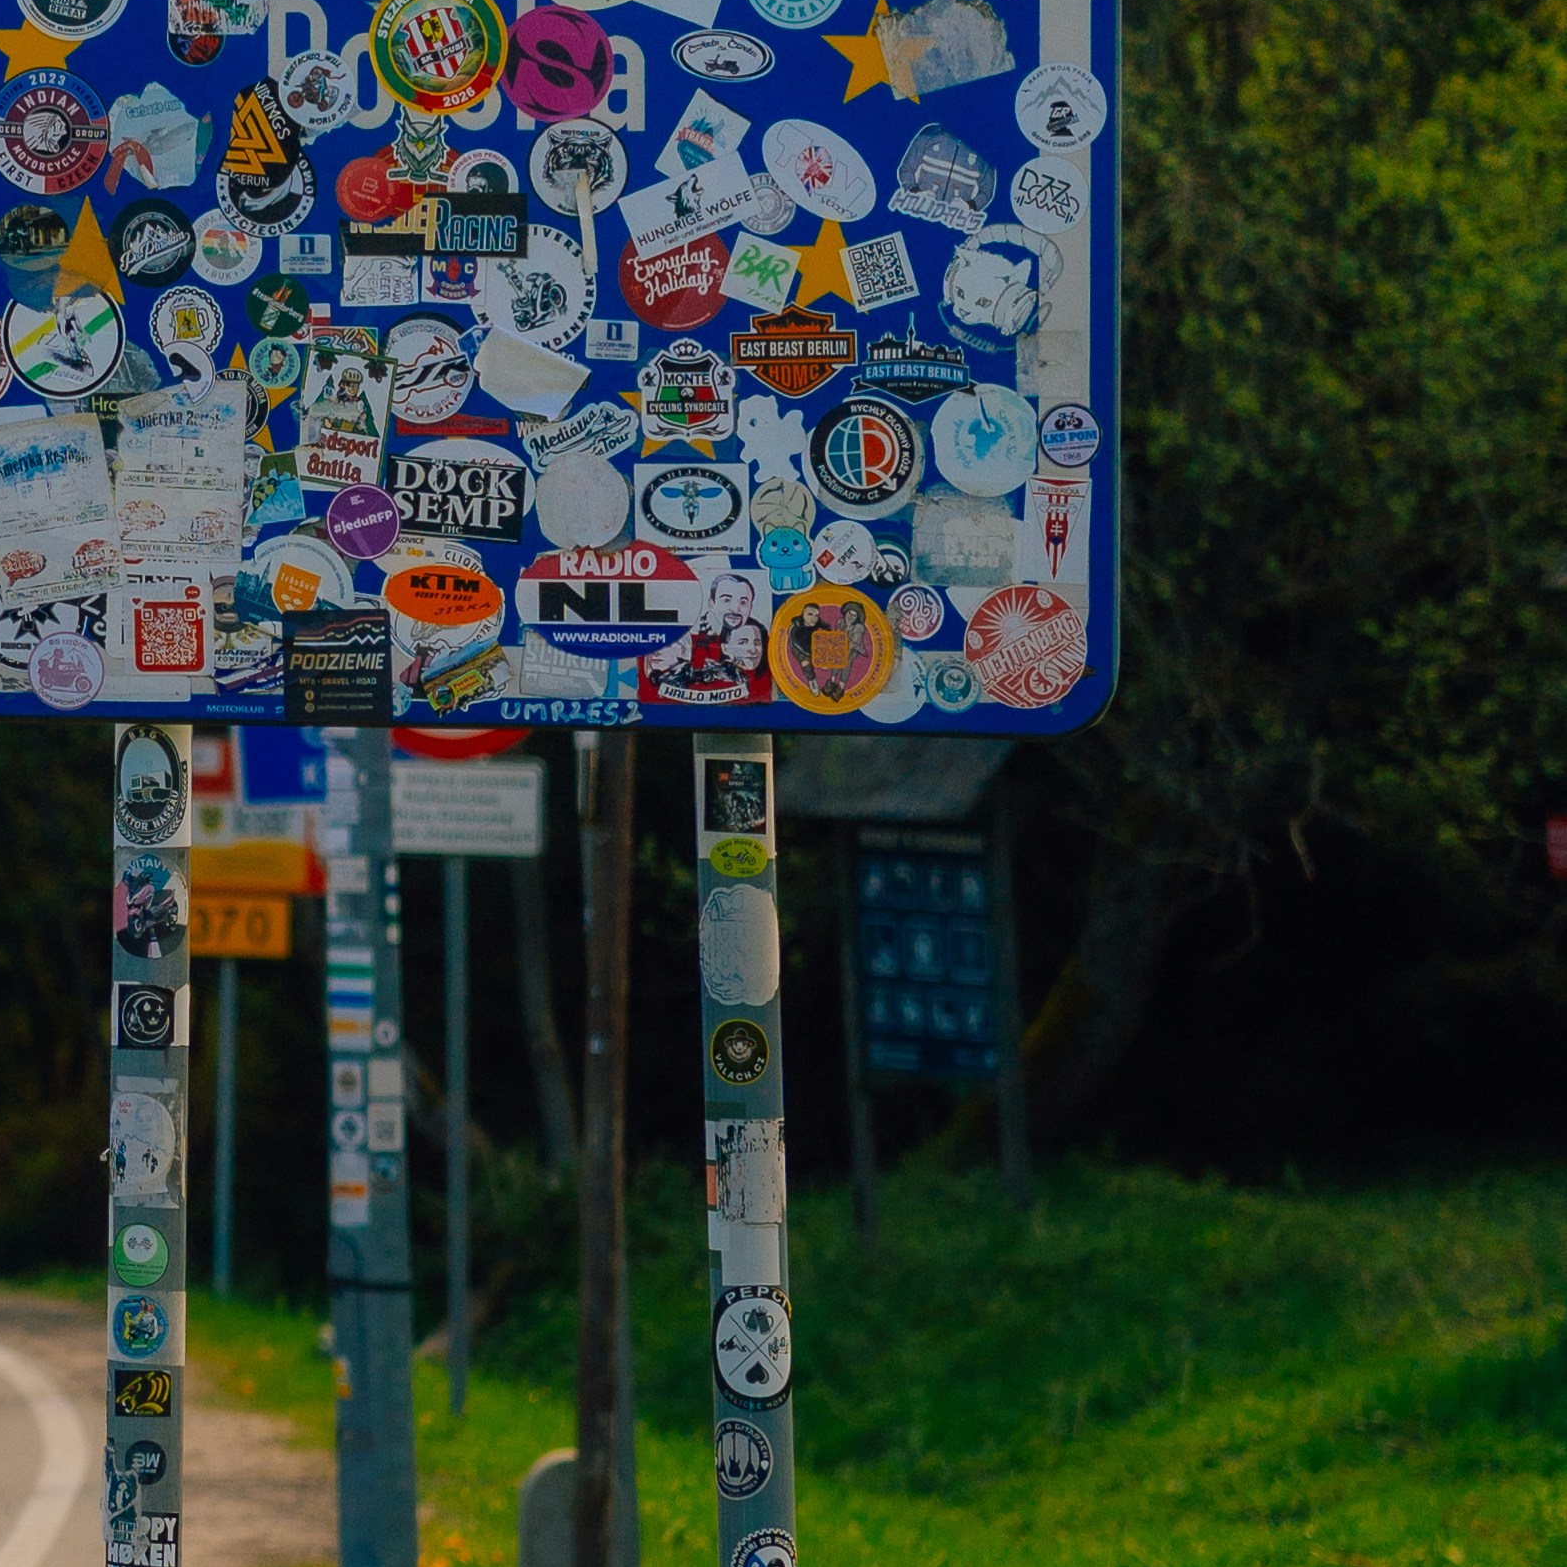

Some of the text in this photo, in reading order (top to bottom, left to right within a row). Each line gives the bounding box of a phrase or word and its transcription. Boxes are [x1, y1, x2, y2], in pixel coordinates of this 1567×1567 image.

[49, 4, 87, 19] REPEAT
[29, 72, 65, 85] 2023
[16, 90, 80, 115] INDIAN
[254, 82, 290, 140] VIKINGS
[309, 93, 353, 126] WORLD TOUR
[74, 128, 106, 139] GROUP
[11, 144, 83, 172] MOTORCYCLE
[56, 154, 100, 190] CZECH
[224, 204, 294, 237] SZCZECIN
[425, 198, 517, 253] RACING
[637, 212, 704, 247] HUNGRIGE
[704, 188, 753, 216] WÖLFE
[432, 261, 475, 274] M C
[627, 242, 720, 283] Everyday
[733, 244, 791, 294] BAR
[644, 271, 714, 306] Holiday
[740, 340, 848, 358] EAST BEAST BERLIN
[663, 373, 711, 385] MONTE
[768, 364, 820, 389] HDMC
[866, 364, 964, 382] EAST BEAST BERLIN
[403, 390, 463, 418] POLSKA
[649, 402, 726, 413] CYCLING SYNDICATE
[530, 408, 598, 456] Mediálka
[1043, 430, 1098, 445] LKS POM
[867, 488, 882, 501] CZ
[393, 491, 516, 530] SEMP
[441, 524, 463, 534] FHC
[560, 550, 657, 577] RADIO
[410, 574, 480, 592] KTM
[538, 581, 679, 622] NL
[553, 632, 666, 644] WWW.RADIONL.FM
[975, 610, 1080, 680] LICHTENBERG
[289, 652, 386, 671] PODZIEMIE
[664, 687, 742, 702] HALLO MOTO
[206, 704, 265, 714] MOTOKLUB
[117, 790, 179, 832] TRAKTOR NASSAU
[715, 1056, 766, 1082] VALACH.CZ
